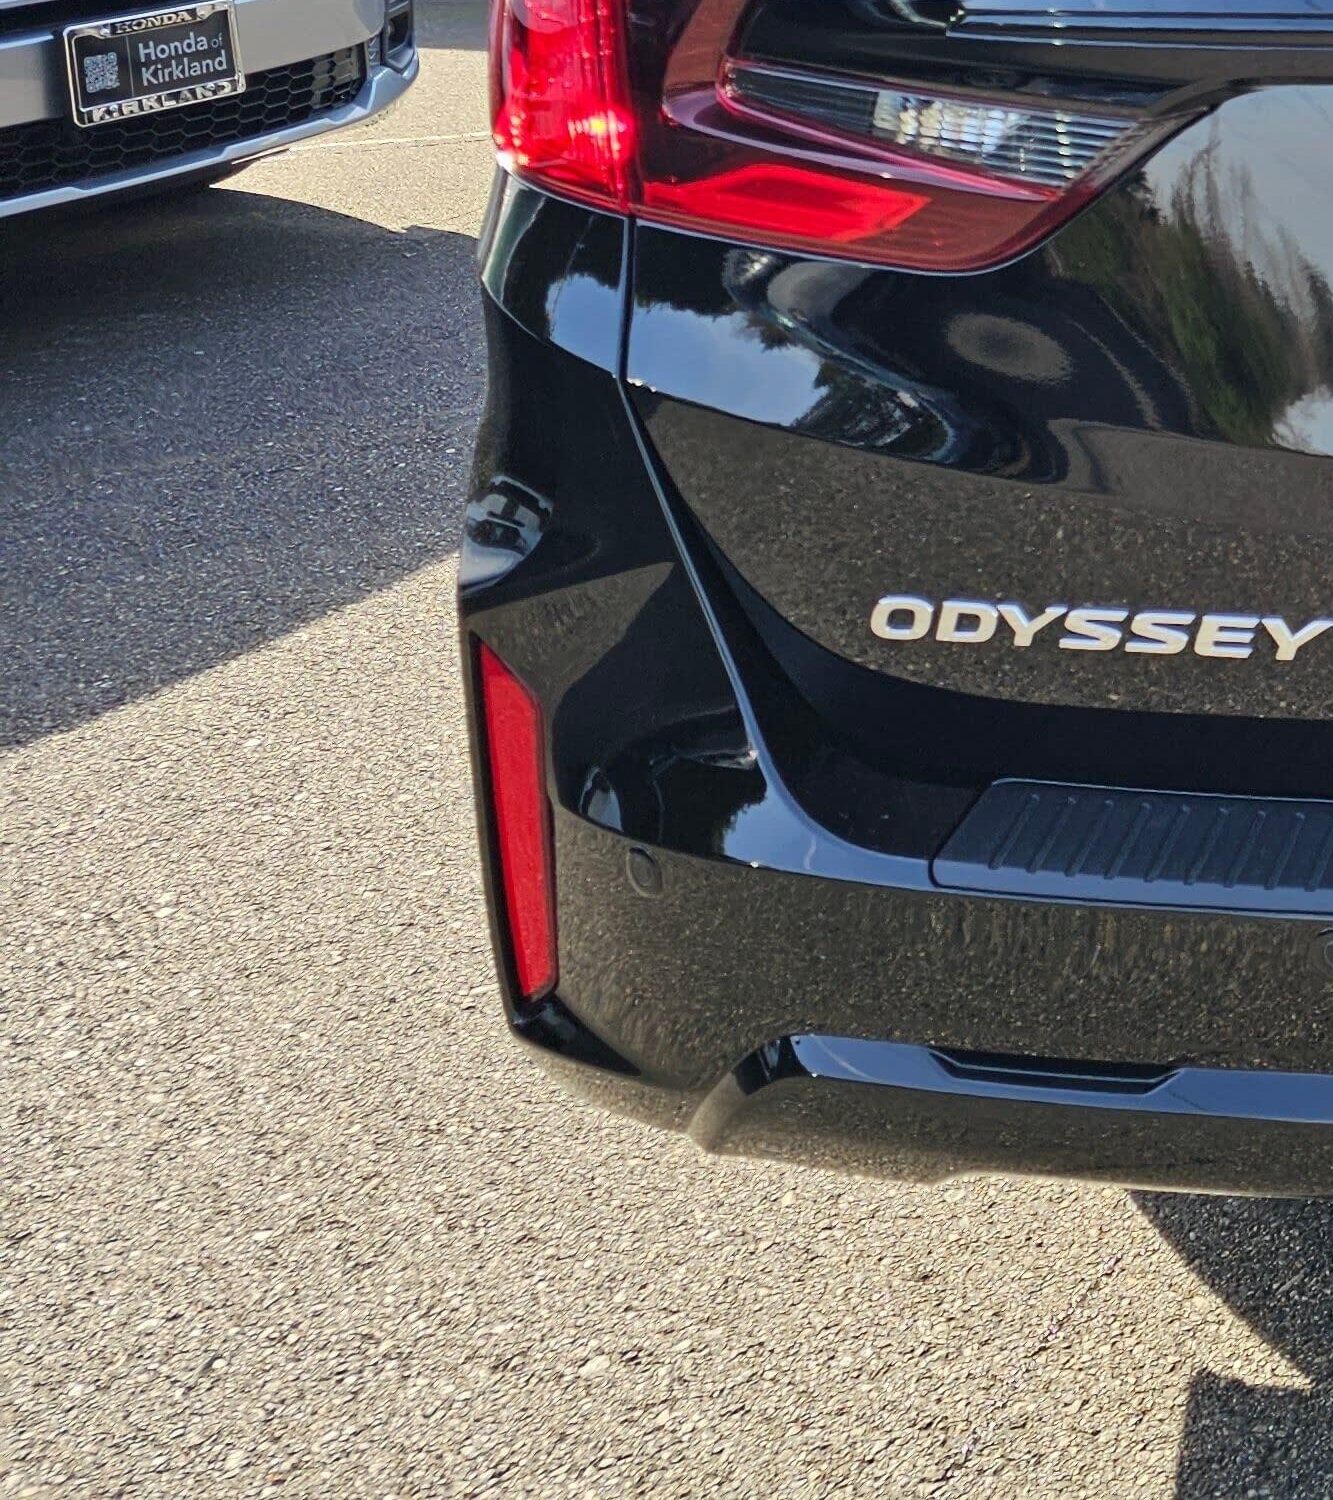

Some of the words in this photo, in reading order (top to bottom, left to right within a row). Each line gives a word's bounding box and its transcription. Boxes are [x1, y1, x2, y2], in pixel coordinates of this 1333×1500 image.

[115, 11, 192, 34] HONDA
[138, 31, 208, 62] Honda
[211, 33, 223, 48] of
[141, 50, 227, 86] Kirkland
